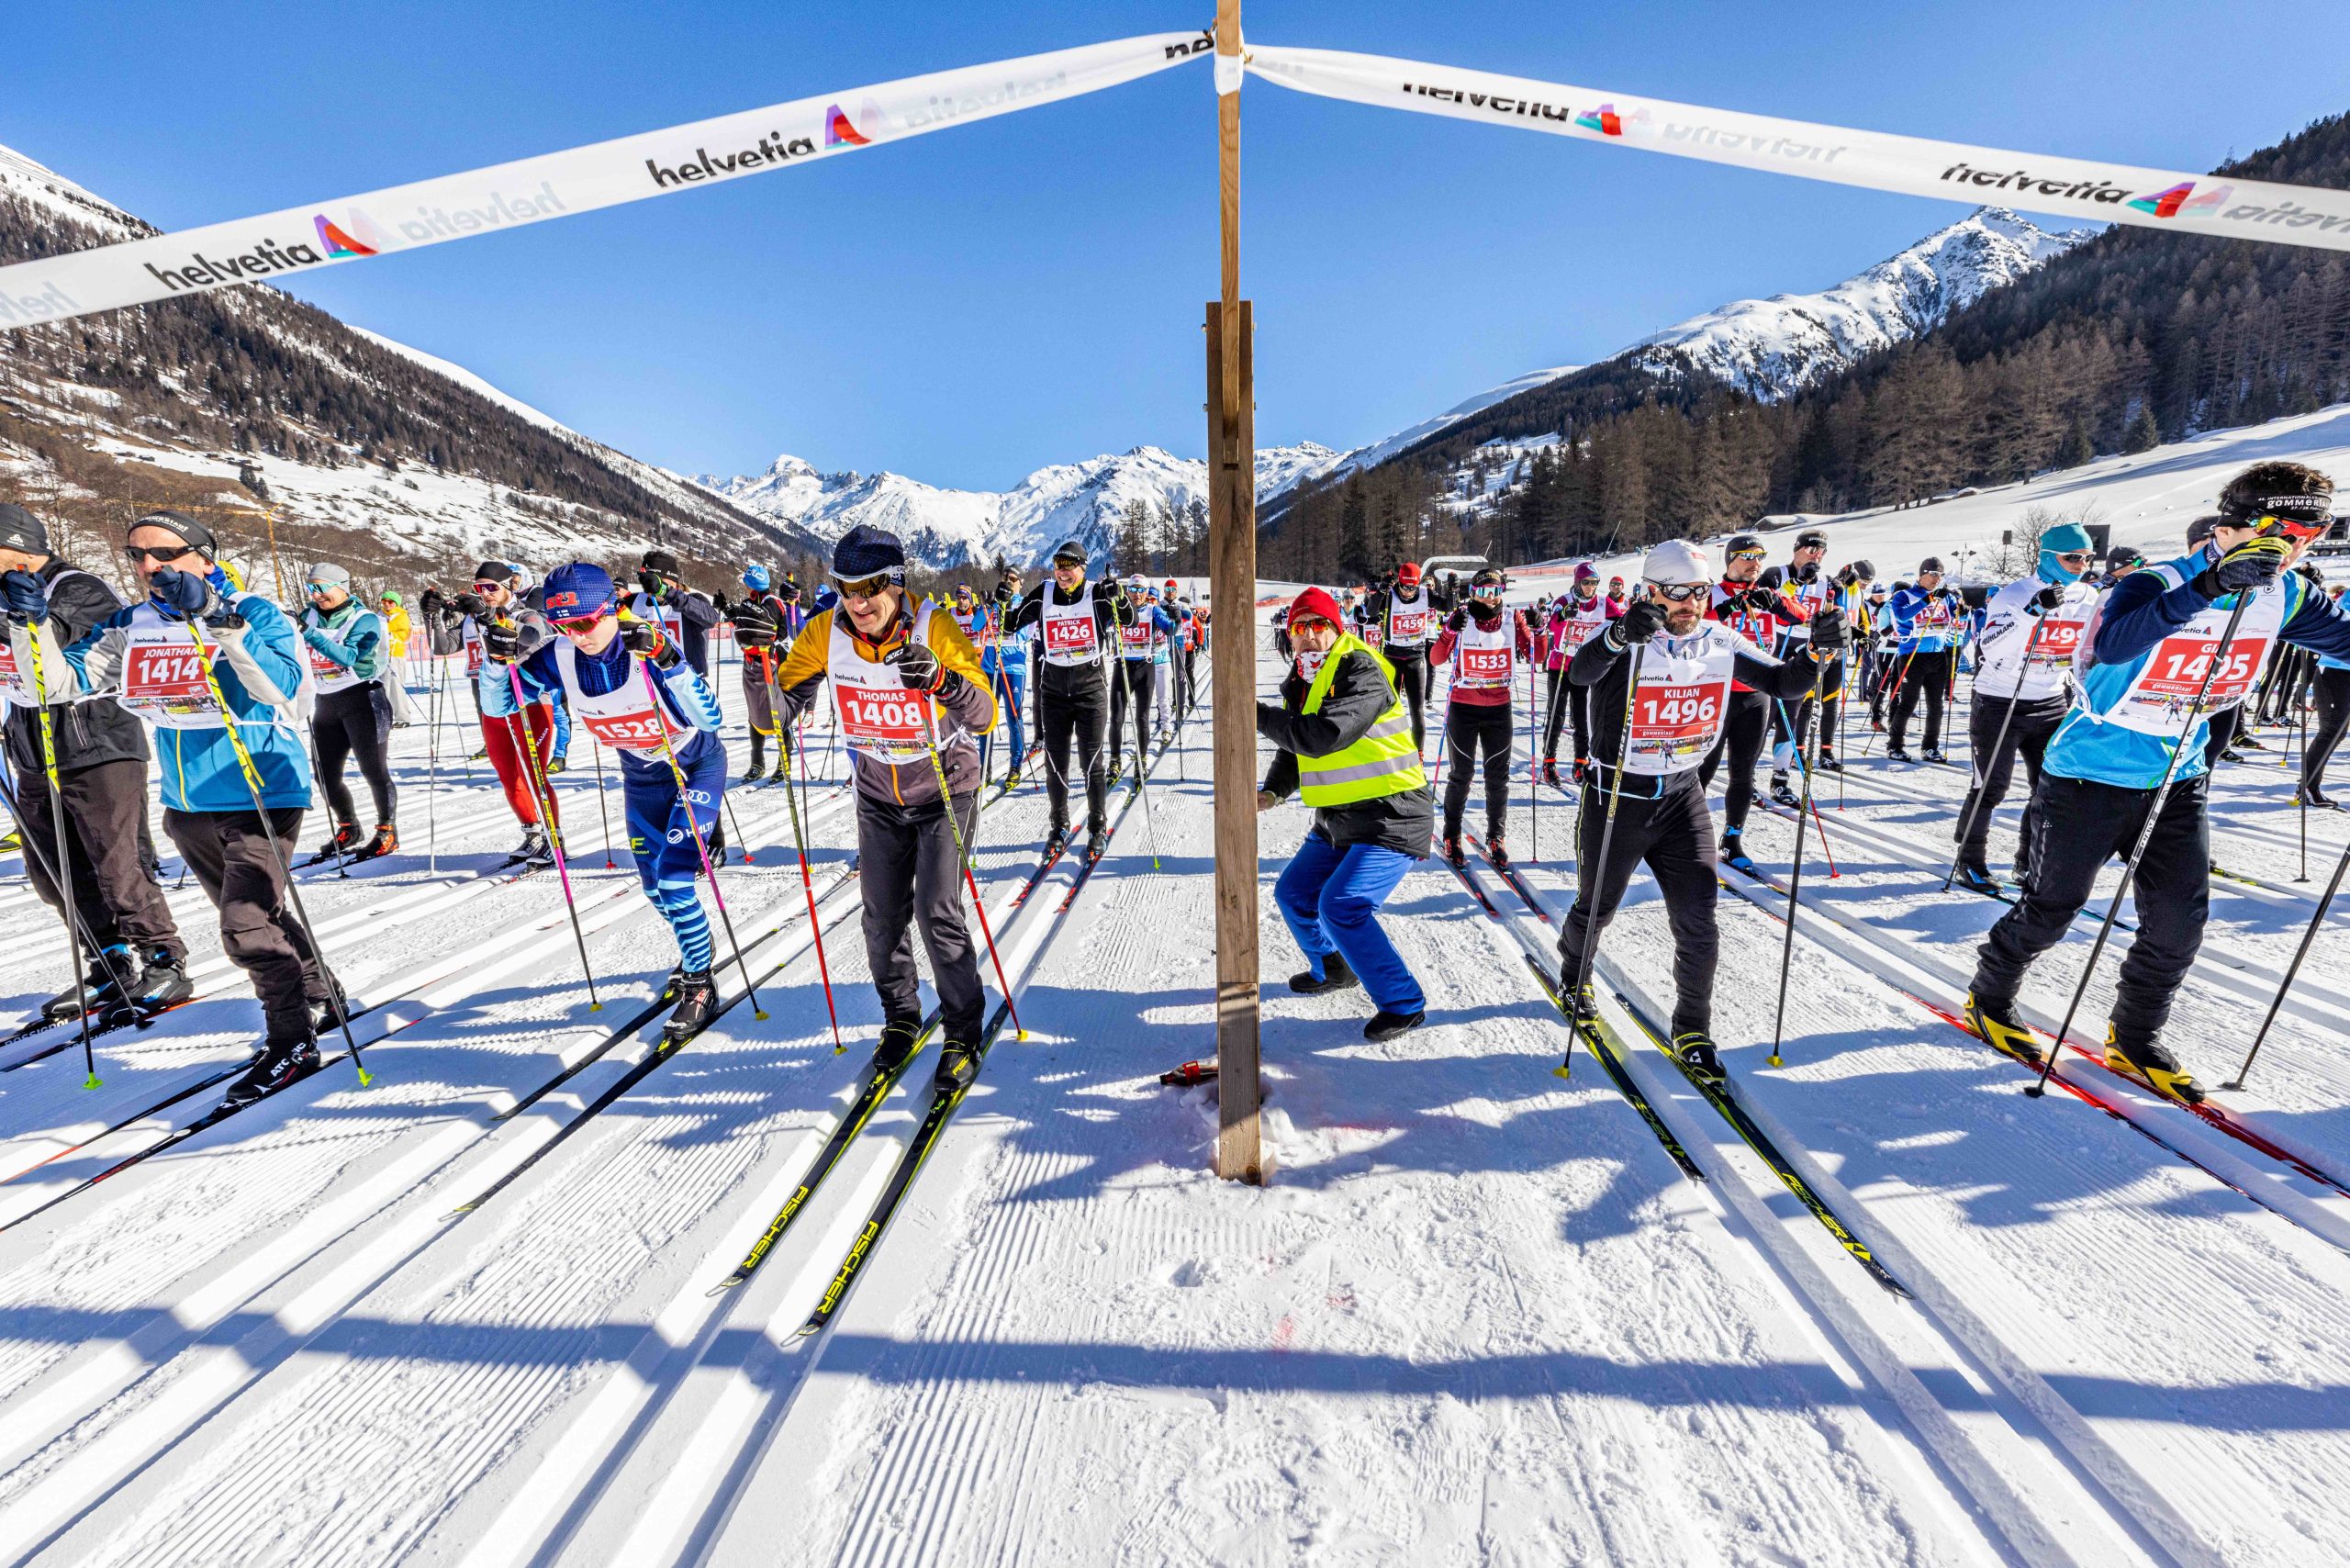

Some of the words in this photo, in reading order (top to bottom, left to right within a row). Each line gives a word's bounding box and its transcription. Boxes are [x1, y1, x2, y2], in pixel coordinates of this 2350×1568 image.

[644, 131, 817, 187] helvetia
[1940, 162, 2136, 204] helvetia
[144, 239, 322, 291] helvetia
[1051, 624, 1091, 642] 1426
[1120, 627, 1147, 637] 1491
[1395, 618, 1424, 630] 1459
[143, 647, 198, 658] JONATHAN
[1468, 654, 1508, 669] 1533
[138, 657, 200, 684] 1414
[834, 673, 859, 682] helvetia
[856, 690, 906, 701] THOMAS
[1664, 688, 1700, 699] KILIAN
[846, 700, 923, 726] 1408
[1643, 697, 1716, 724] 1496
[1810, 700, 1818, 728] LEKI
[595, 718, 661, 738] 1528
[1781, 1172, 1849, 1239] FISCHER
[742, 1185, 809, 1269] FISCHER
[816, 1220, 879, 1314] FISCHER
